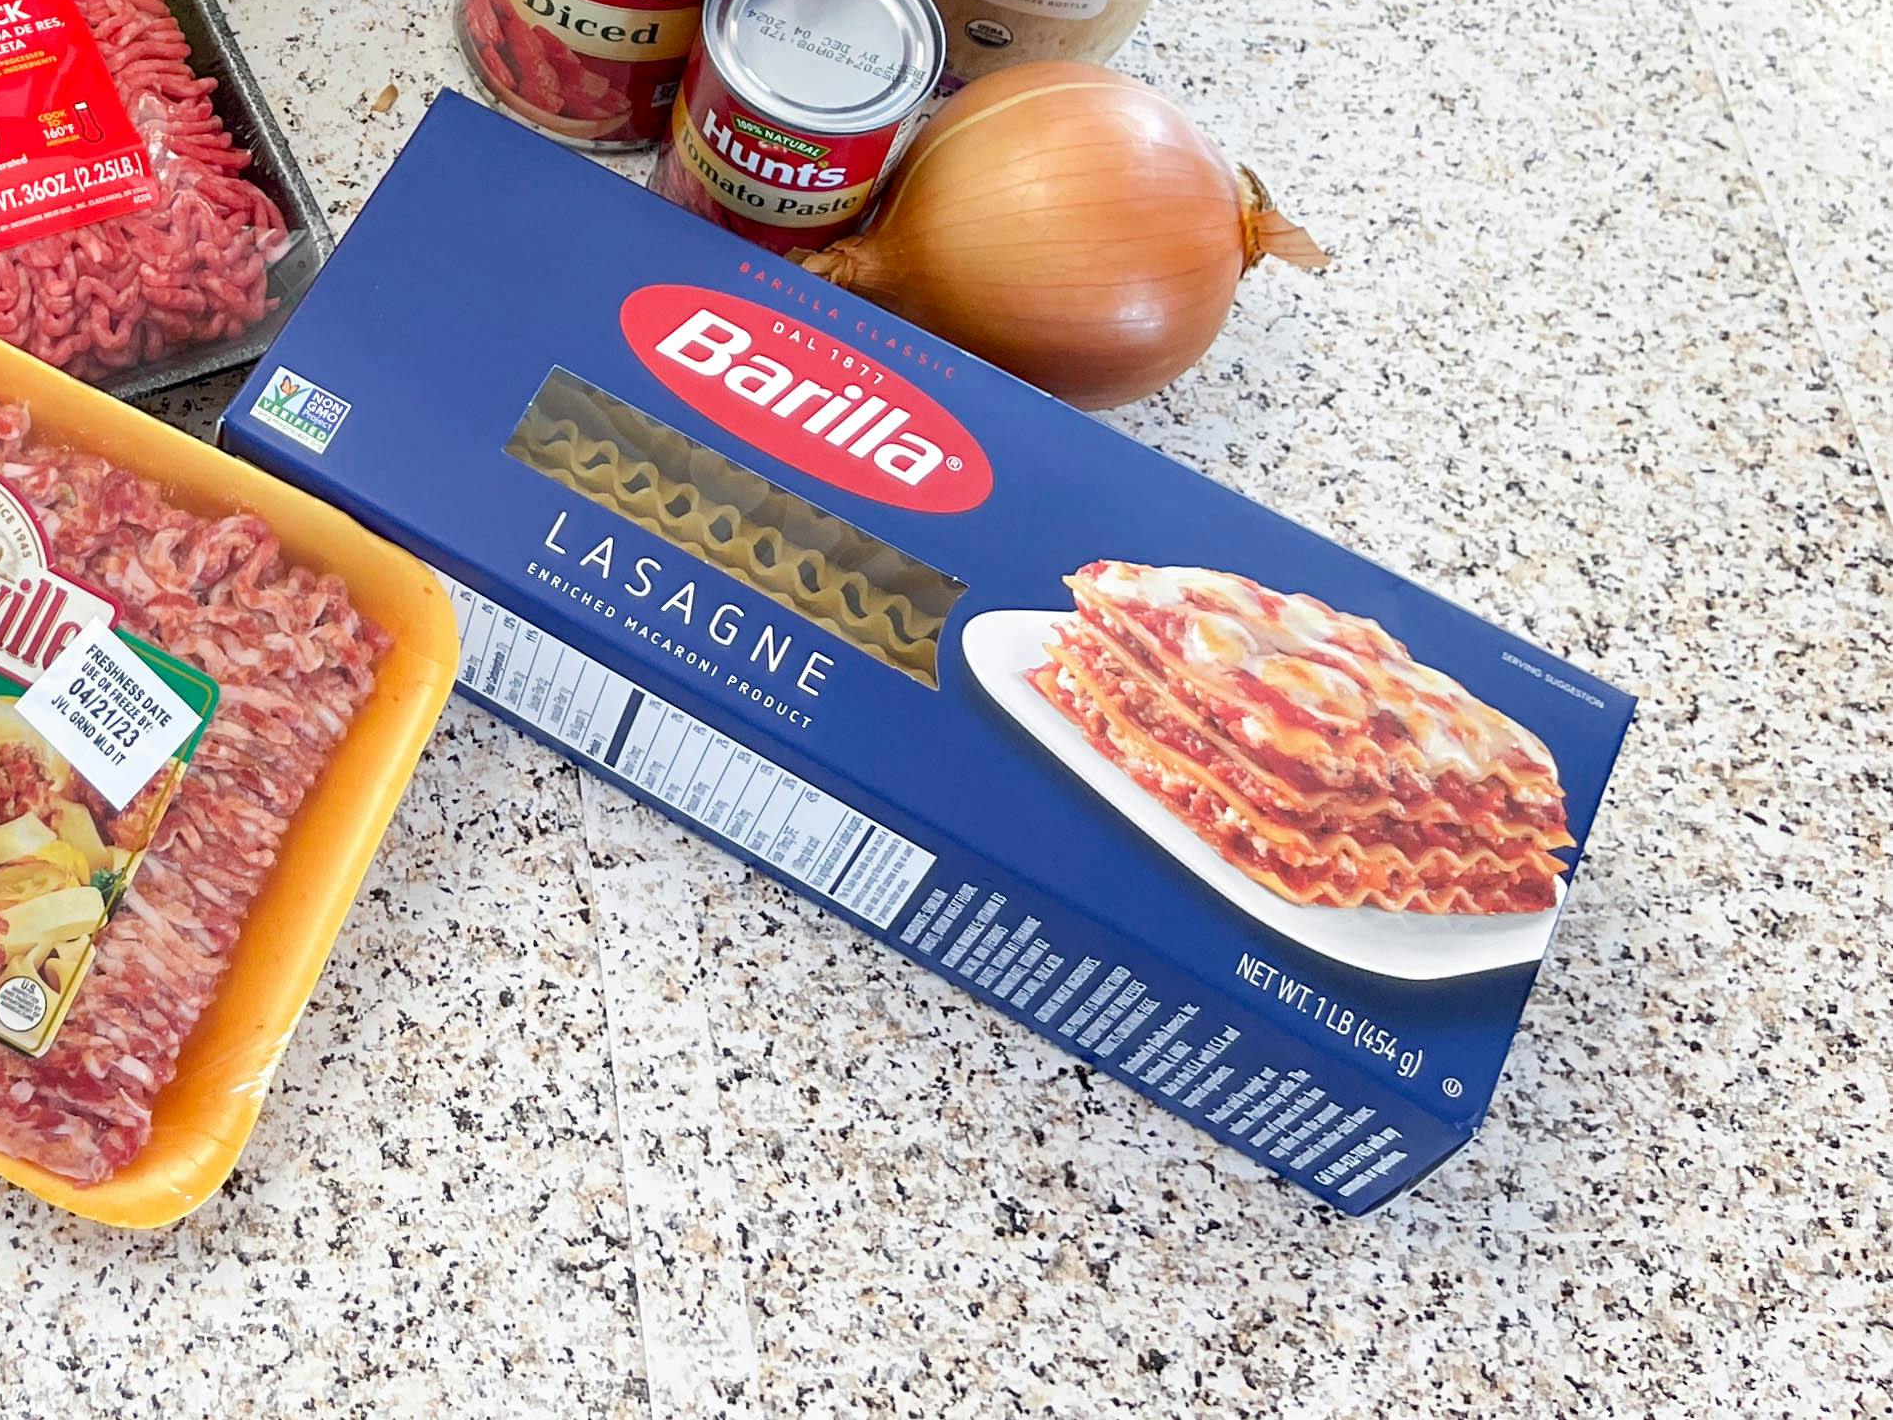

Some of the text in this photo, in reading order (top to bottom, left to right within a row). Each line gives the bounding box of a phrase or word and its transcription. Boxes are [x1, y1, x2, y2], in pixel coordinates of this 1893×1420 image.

[14, 23, 34, 36] DE
[35, 17, 66, 32] RES,
[1048, 0, 1089, 10] BOTTLE
[3, 56, 58, 75] INGREDIENTS
[38, 110, 67, 123] COOK
[42, 124, 75, 140] 160°F
[735, 117, 822, 158] 100% NATURAL
[679, 121, 859, 217] Tomato Paste
[738, 261, 956, 380] BARILLA CLASSIC
[773, 320, 885, 385] DAL 1877
[262, 399, 327, 441] VERIFIED
[301, 409, 333, 431] Project
[306, 401, 338, 423] GMO
[312, 391, 344, 414] NON
[655, 308, 946, 487] Barilla
[13, 527, 32, 559] 1945
[544, 511, 835, 697] LASAGNE
[526, 561, 814, 729] ENRICHED MACARONI PRODUCT
[81, 661, 97, 681] USE
[97, 677, 111, 693] OR
[108, 687, 137, 721] FREEZE
[85, 643, 173, 728] FRESHNESS DATE
[1502, 651, 1605, 709] SERVING SUGGESTION
[50, 694, 127, 766] JVL GRND MLD IT
[68, 677, 140, 748] 04/21/23
[1235, 952, 1424, 1079] NET WT. 1 LB (454 g)
